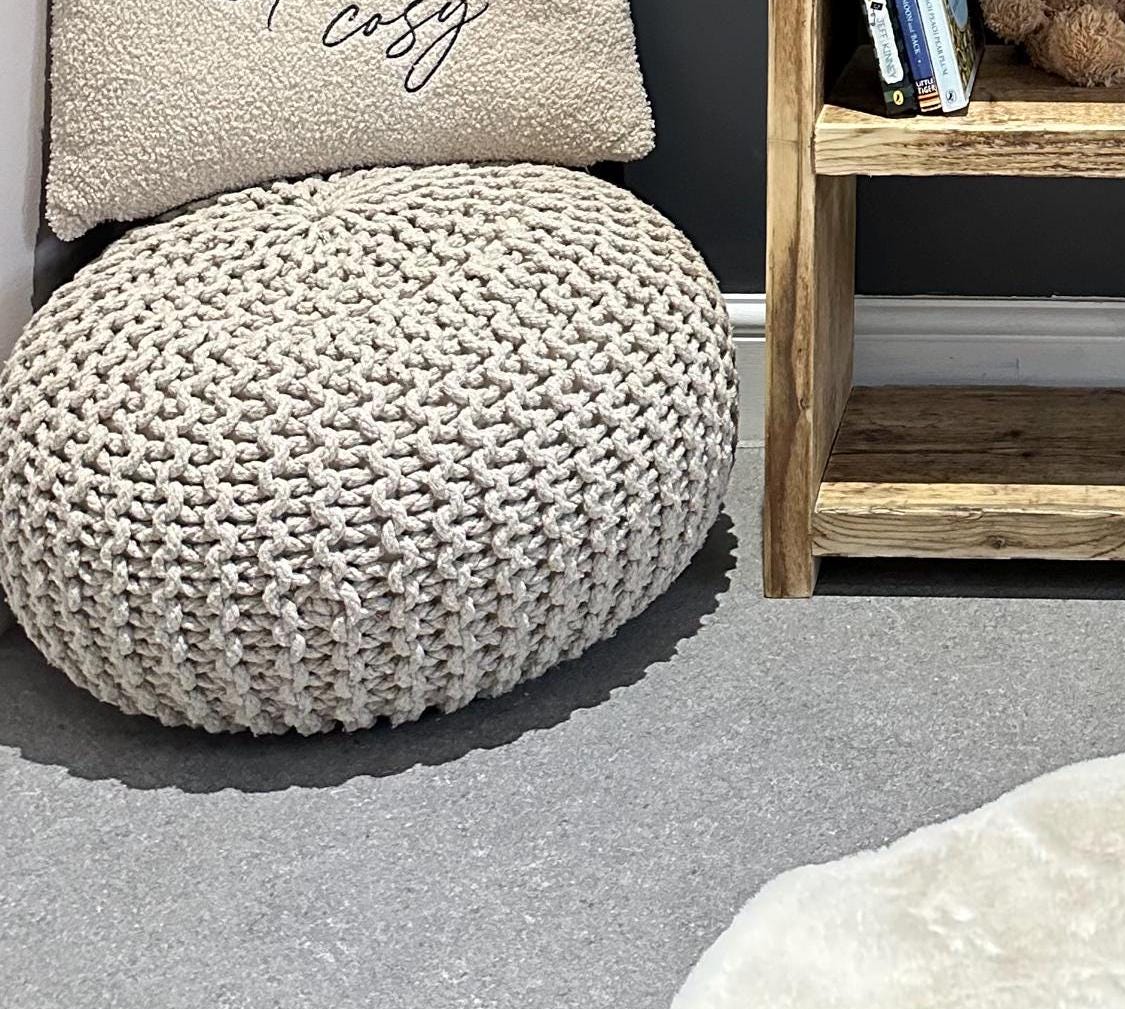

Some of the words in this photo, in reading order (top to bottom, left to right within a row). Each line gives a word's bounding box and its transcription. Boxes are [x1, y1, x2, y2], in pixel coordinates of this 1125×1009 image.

[877, 18, 887, 39] JEFF
[911, 34, 920, 54] BACK
[880, 42, 895, 79] KINNEY
